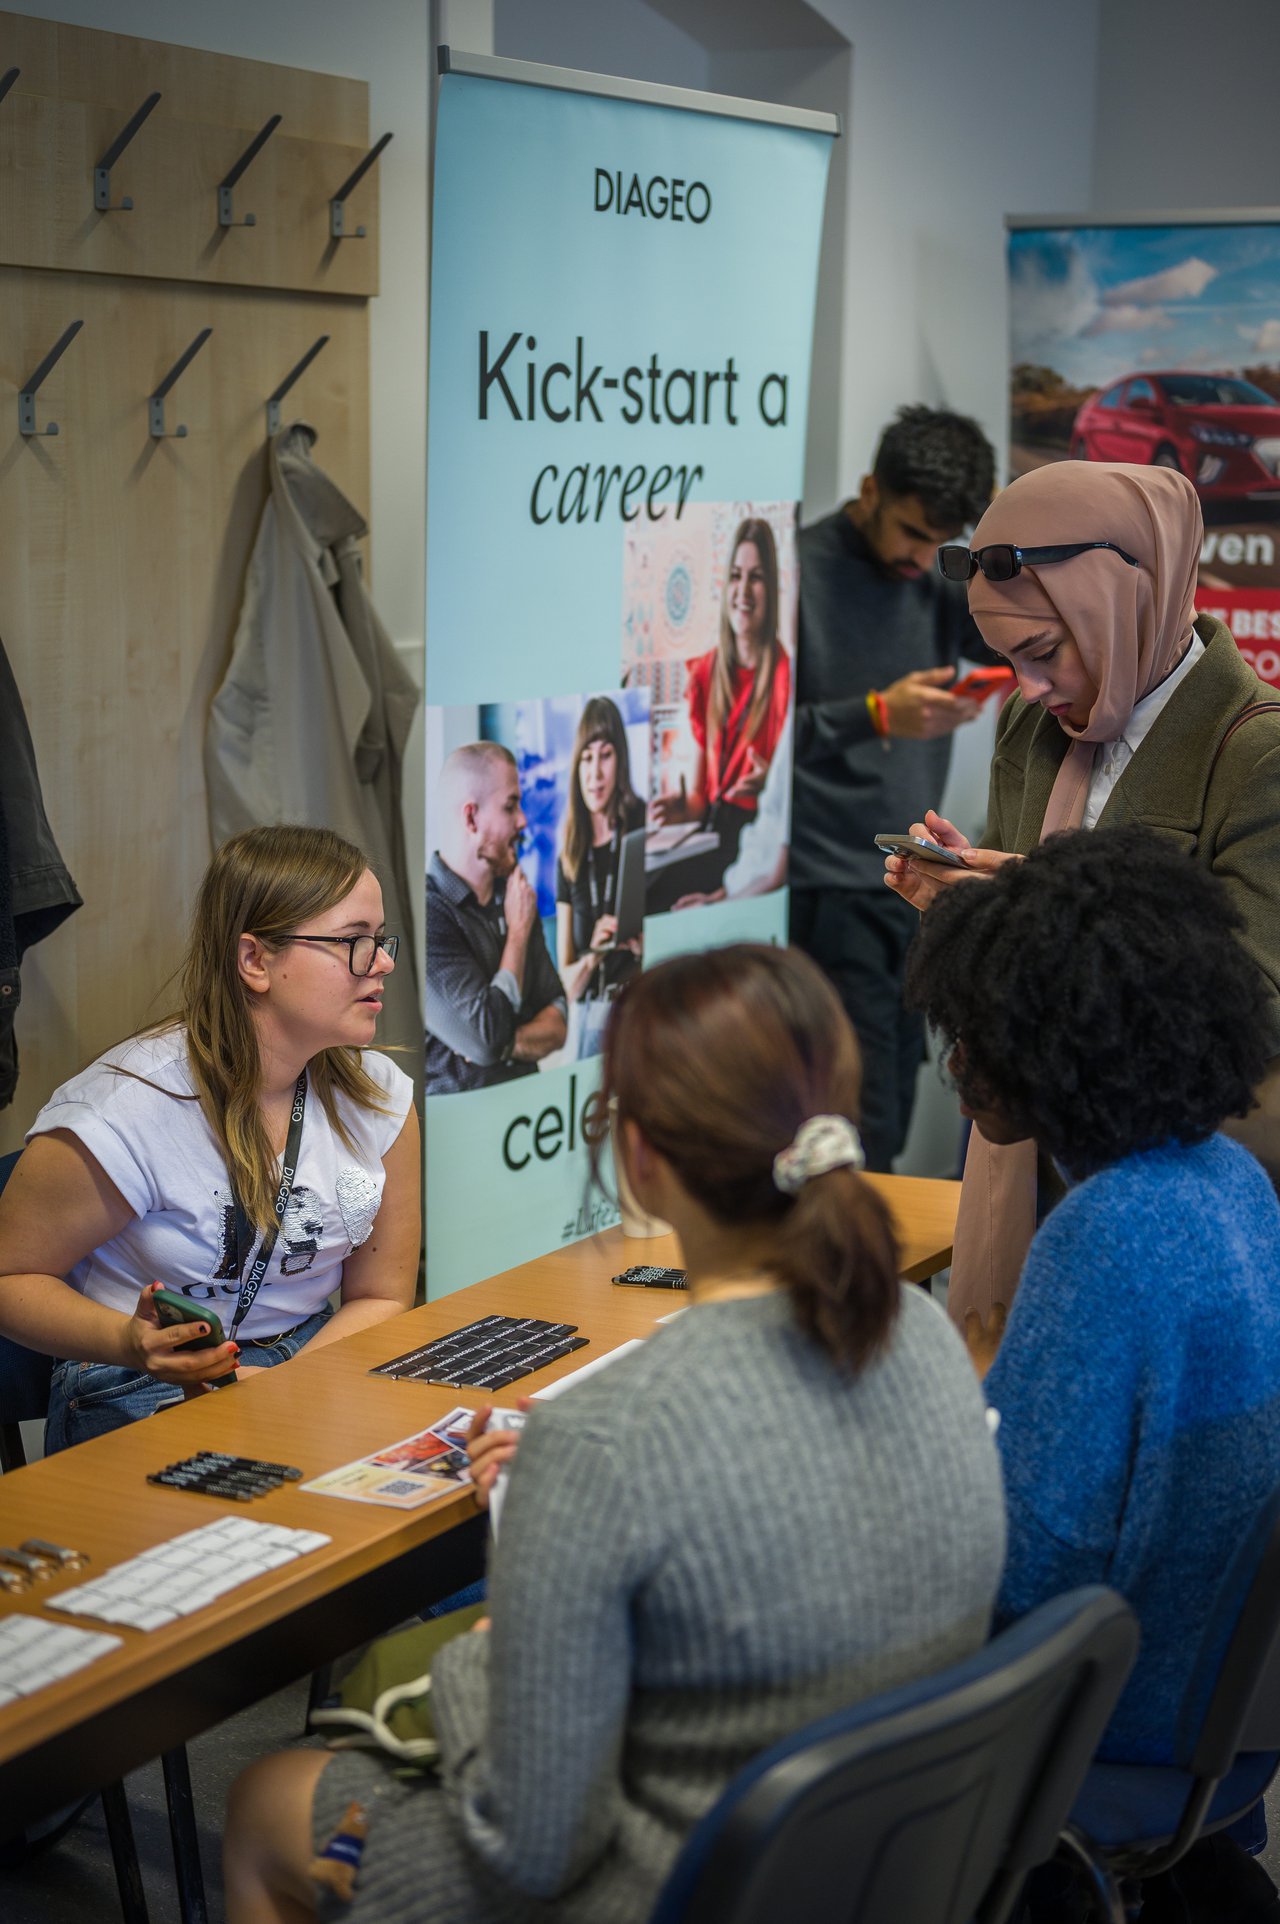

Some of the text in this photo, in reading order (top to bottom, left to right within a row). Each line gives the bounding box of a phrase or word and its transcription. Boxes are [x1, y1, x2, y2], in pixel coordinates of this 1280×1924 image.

[593, 167, 713, 224] DIAGEO
[477, 329, 789, 428] Kick-start a
[528, 459, 705, 527] career
[275, 1166, 294, 1214] DIAGEO
[242, 1260, 266, 1308] DIAGEO
